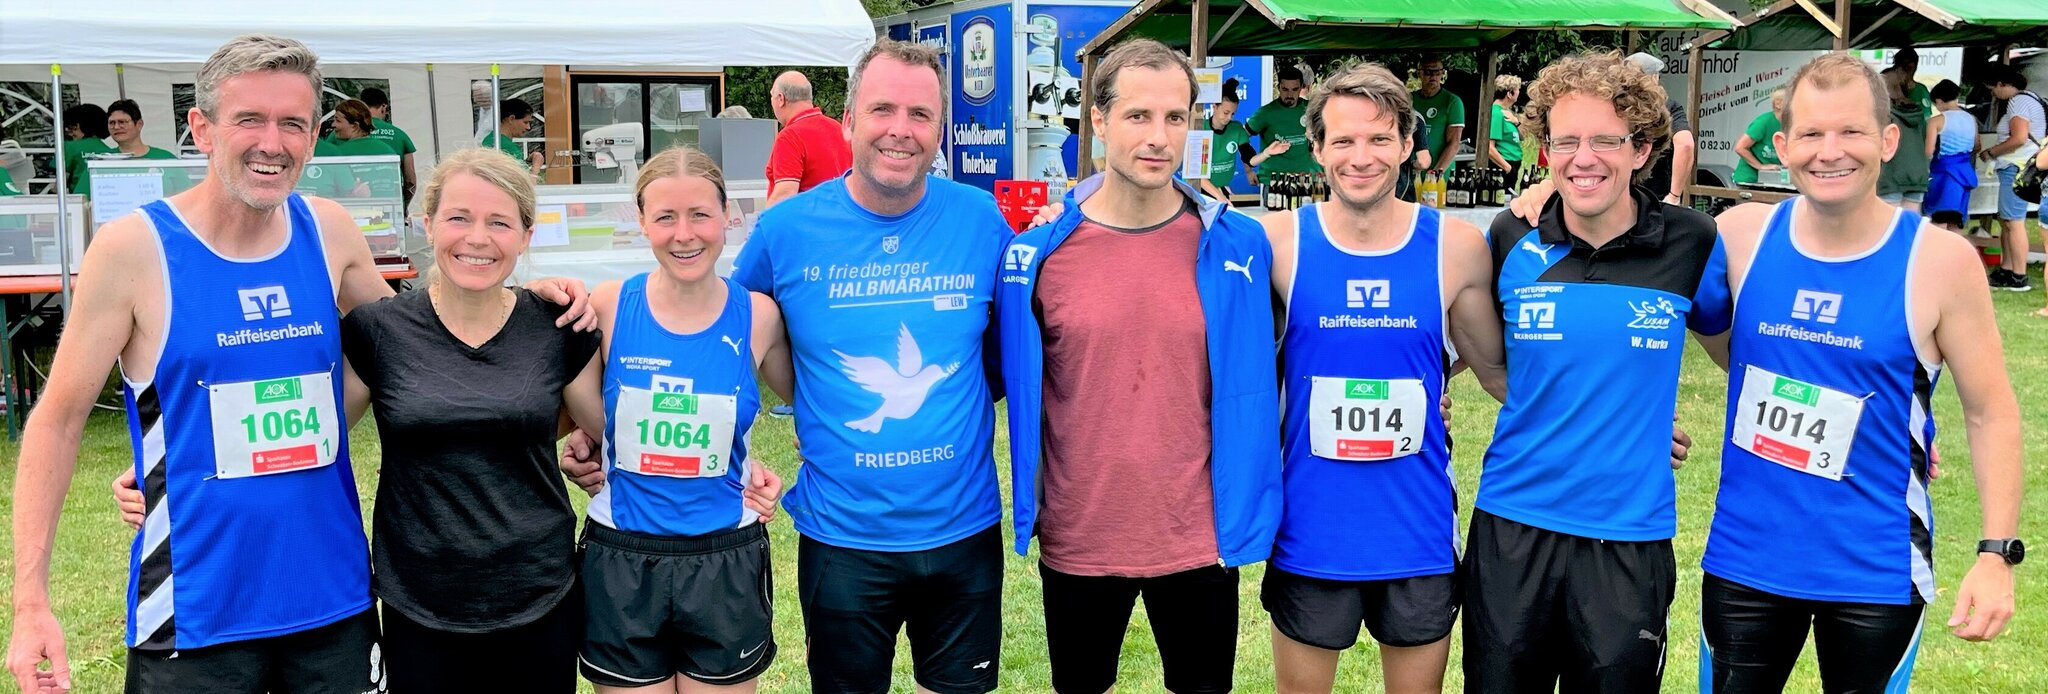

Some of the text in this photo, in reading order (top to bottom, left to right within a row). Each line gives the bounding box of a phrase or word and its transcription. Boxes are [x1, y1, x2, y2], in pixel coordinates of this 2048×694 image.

[1660, 52, 1740, 74] Baunhof
[1700, 85, 1731, 104] Fleisch
[1734, 77, 1752, 92] und
[1755, 67, 1783, 84] Wurst
[1698, 101, 1726, 119] Direkt
[1730, 95, 1749, 108] vom
[953, 122, 1006, 146] Schloßbrauerei
[961, 151, 998, 175] Unterbaar
[802, 261, 930, 282] 19. friedberger
[829, 273, 976, 299] HALBMARATHON
[950, 296, 965, 308] LEW
[1318, 314, 1418, 329] Raiffeisenbank
[216, 320, 324, 348] Raiffeisenbank
[1631, 336, 1643, 348] W.
[1758, 321, 1863, 350] Raiffeisenbank
[626, 356, 673, 368] INTERSPORT
[261, 382, 290, 399] AOK
[1349, 383, 1377, 397] AOK
[1778, 382, 1806, 400] AOK
[657, 395, 686, 411] AOK
[240, 406, 321, 444] 1064
[1331, 406, 1404, 433] 1014
[1756, 400, 1826, 445] 1014
[636, 418, 711, 449] 1064
[1399, 436, 1412, 452] 2
[322, 437, 331, 457] 1
[854, 444, 955, 469] FRIEDBERG
[706, 453, 718, 471] 3
[1816, 452, 1831, 468] 3
